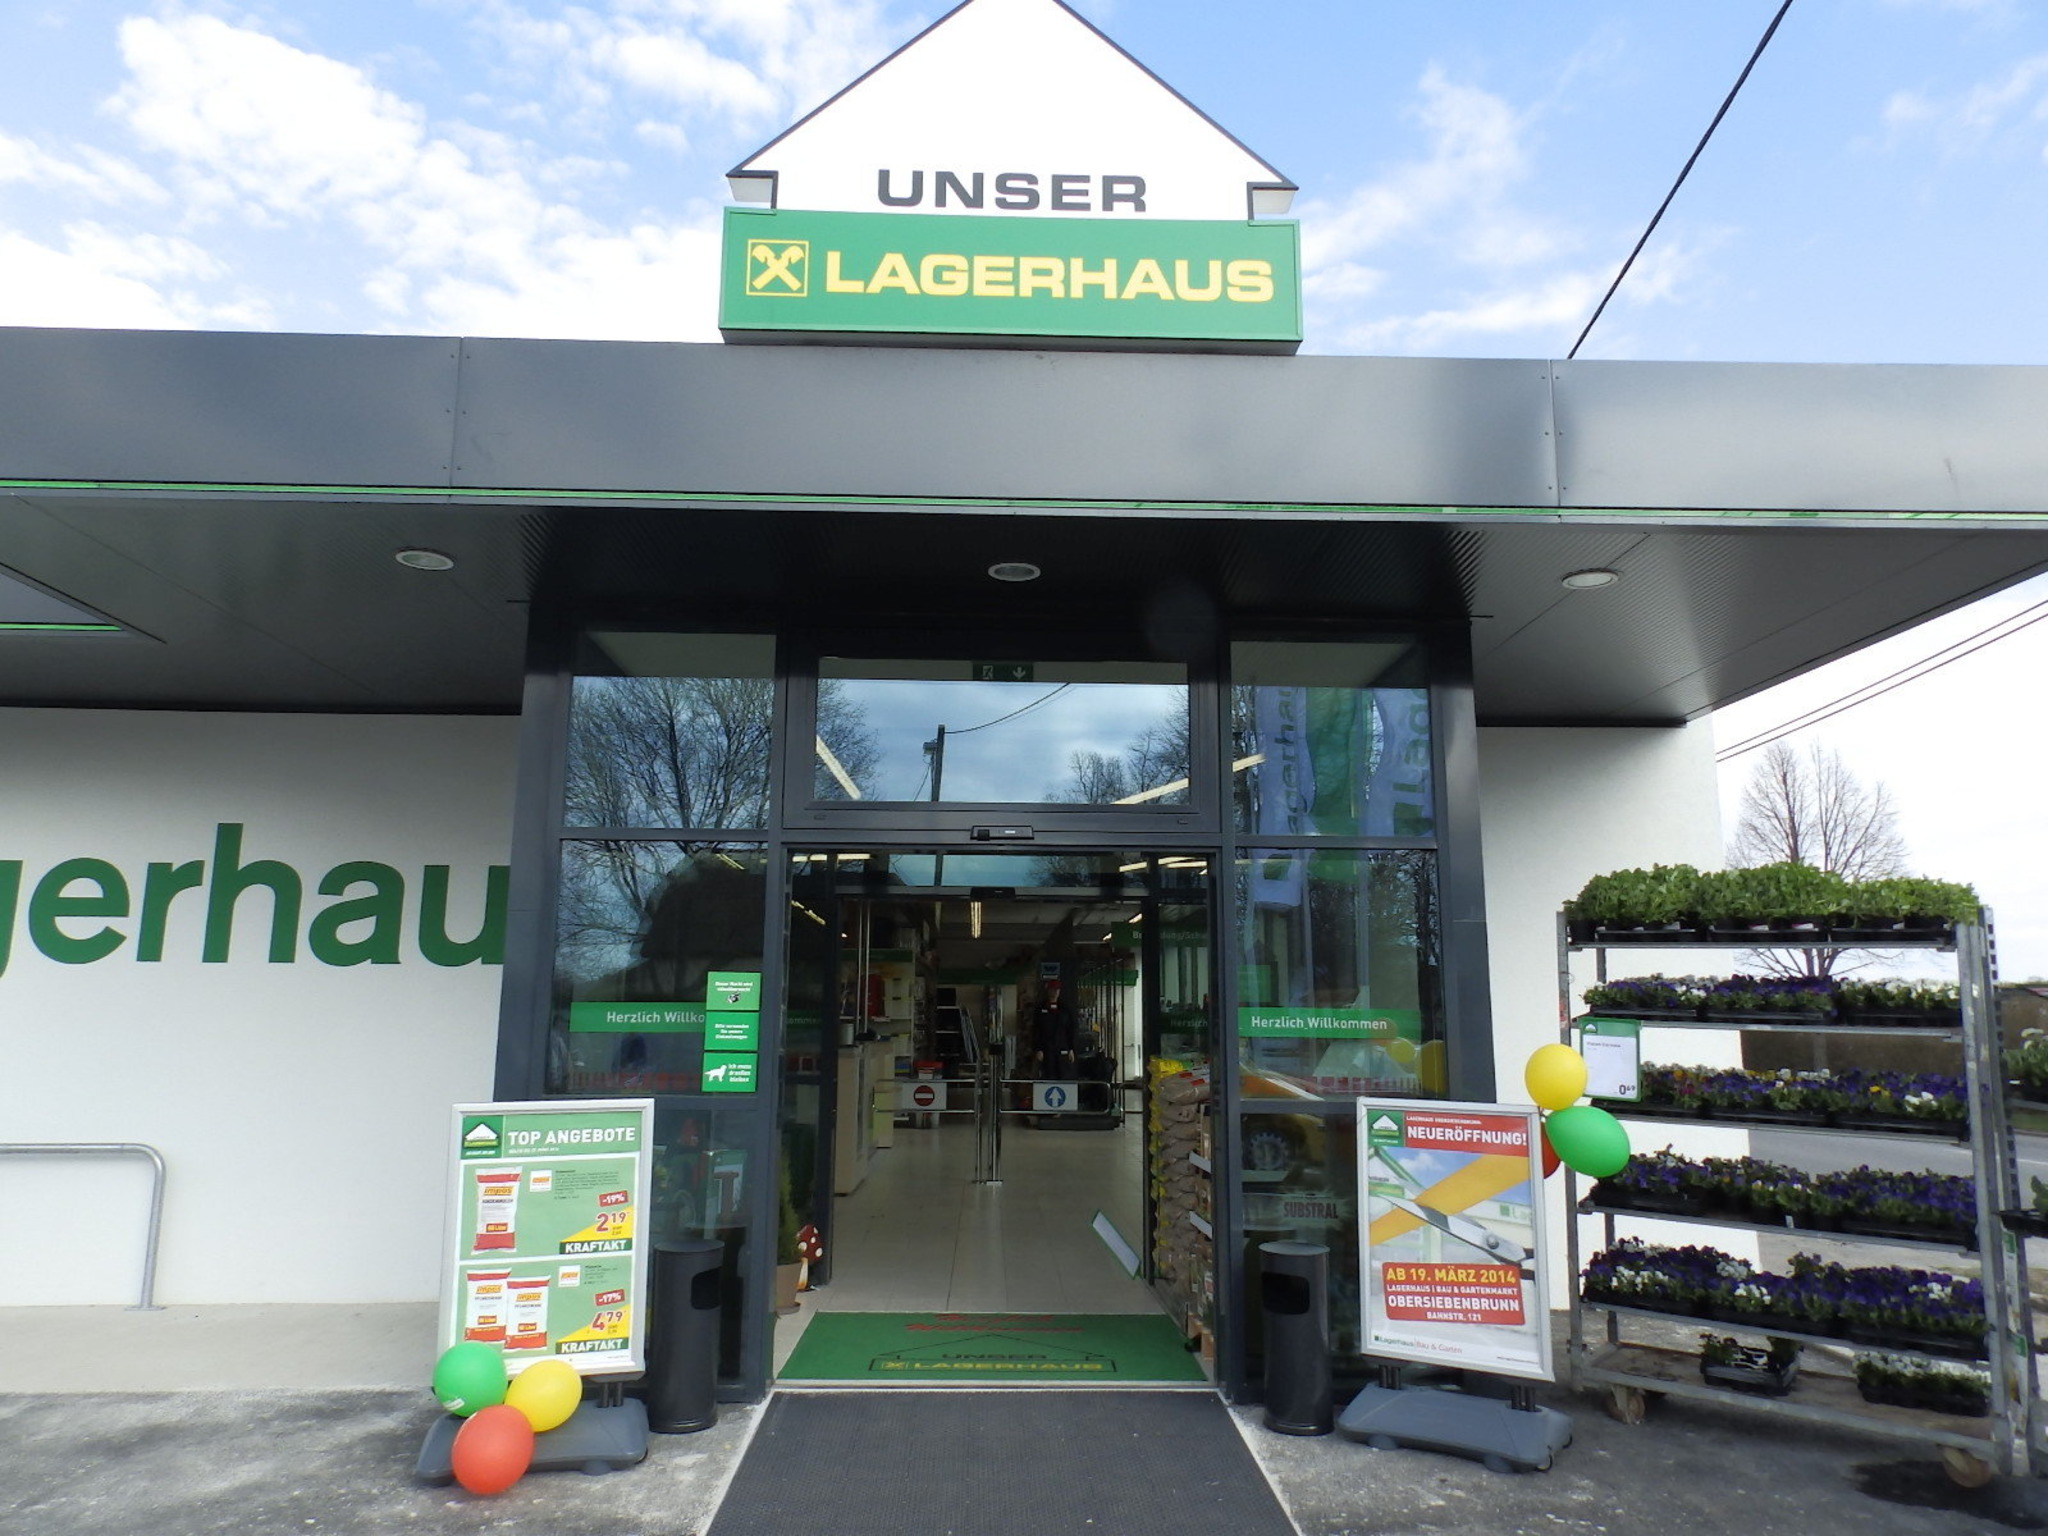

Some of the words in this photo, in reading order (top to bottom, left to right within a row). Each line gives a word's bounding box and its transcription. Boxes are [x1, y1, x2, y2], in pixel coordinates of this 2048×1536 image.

[877, 168, 1146, 213] UNSER
[825, 250, 1275, 303] LAGERHAUS
[606, 1011, 661, 1023] Herzlich
[1251, 1015, 1304, 1028] Herzlich
[1307, 1016, 1388, 1031] Willkommen
[507, 1130, 541, 1146] TOP
[544, 1127, 636, 1145] ANGEBOTE
[1407, 1125, 1527, 1146] NEUERÖFFNUNG!
[1283, 1201, 1339, 1219] SUBSTRAL
[565, 1239, 627, 1254] KRAFTAKT
[1386, 1267, 1406, 1281] AB
[1409, 1267, 1431, 1281] 19.
[1434, 1265, 1477, 1282] MÄRZ
[1480, 1269, 1516, 1284] 2014
[1386, 1284, 1431, 1293] LAGERHAUS
[1436, 1284, 1452, 1293] BAU
[1460, 1286, 1518, 1296] GARTENMARKT
[1388, 1295, 1520, 1311] OBERSIEBENBRUNN
[1468, 1313, 1482, 1322] 121
[561, 1338, 624, 1354] KRAFTAKT
[914, 1362, 1102, 1370] LAGERHAUS
